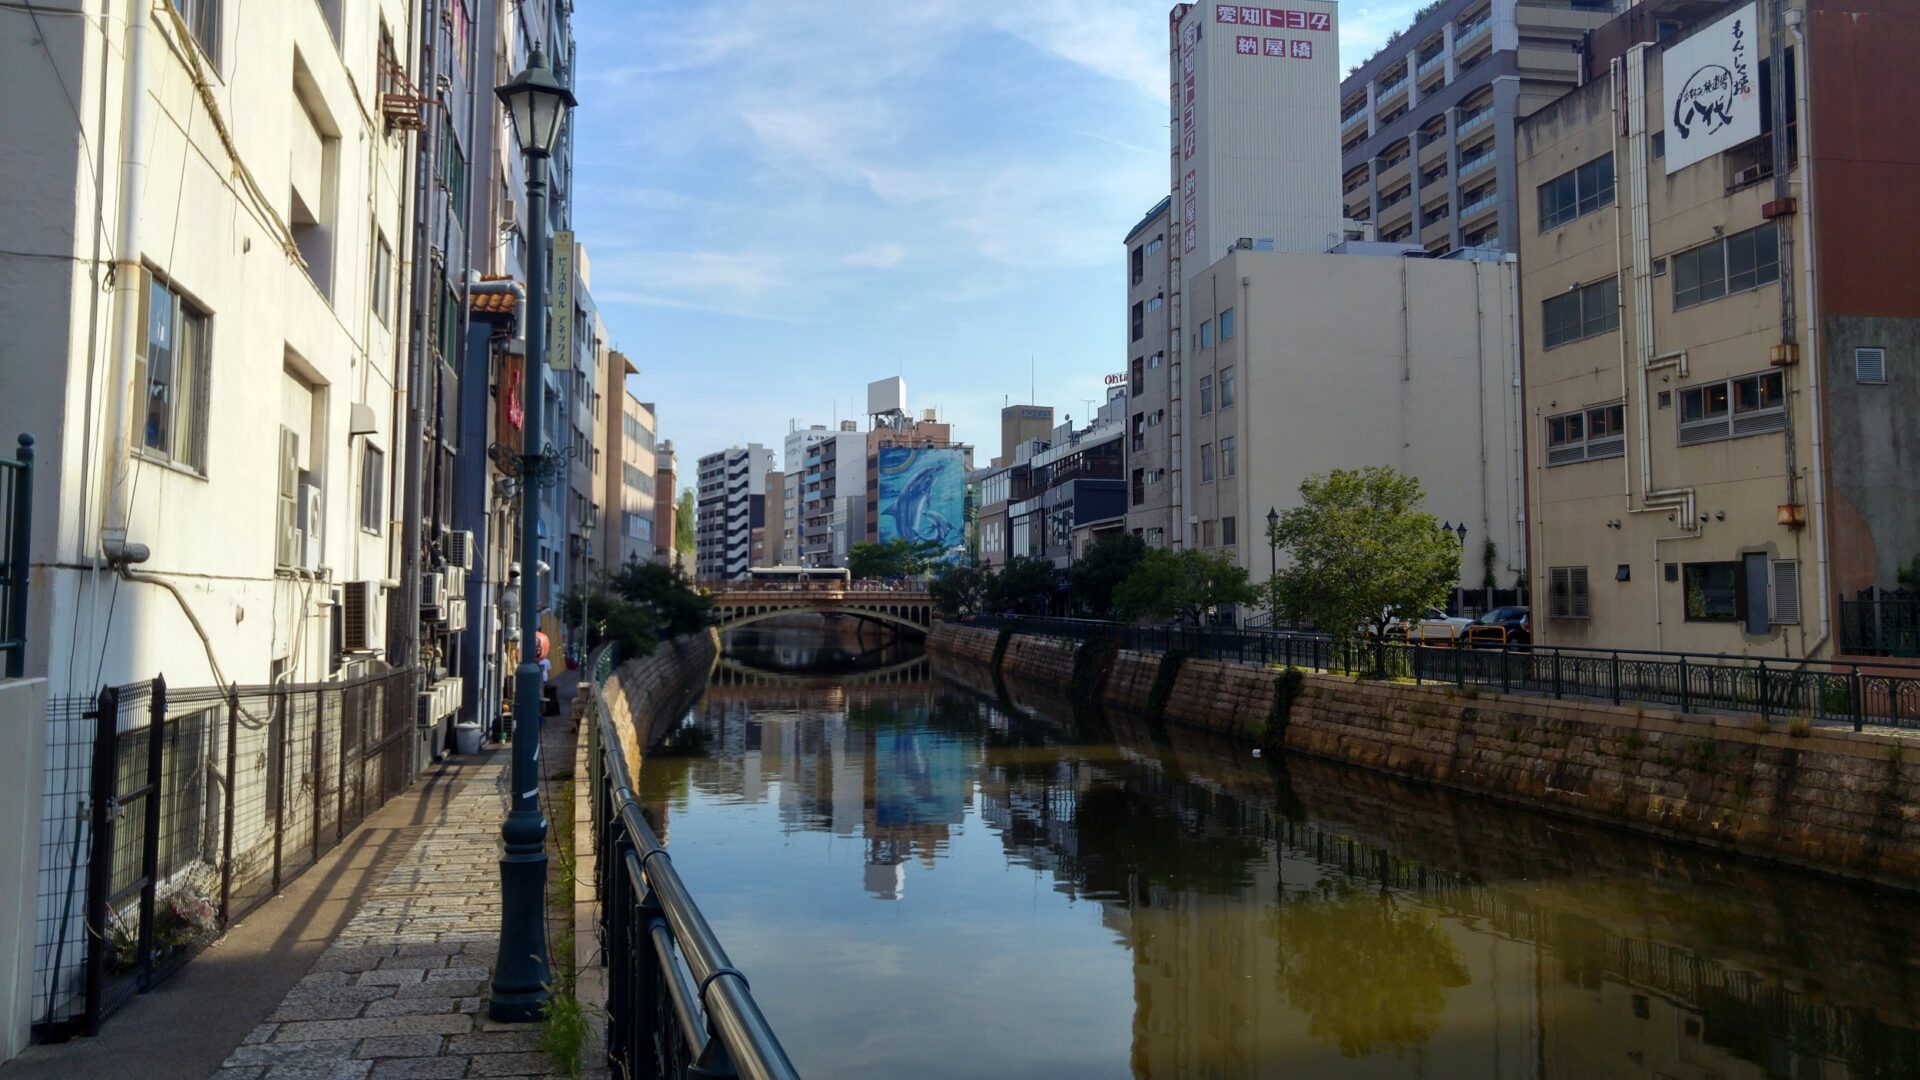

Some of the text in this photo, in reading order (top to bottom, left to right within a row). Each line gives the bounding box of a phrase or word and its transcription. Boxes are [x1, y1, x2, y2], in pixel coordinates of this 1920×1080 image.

[1217, 5, 1330, 31] 愛知トヨタ
[1237, 36, 1312, 59] 納屋橋
[1731, 19, 1751, 97] もんじゃ焼
[1183, 22, 1196, 254] 愛知トヨタ 納屋橋
